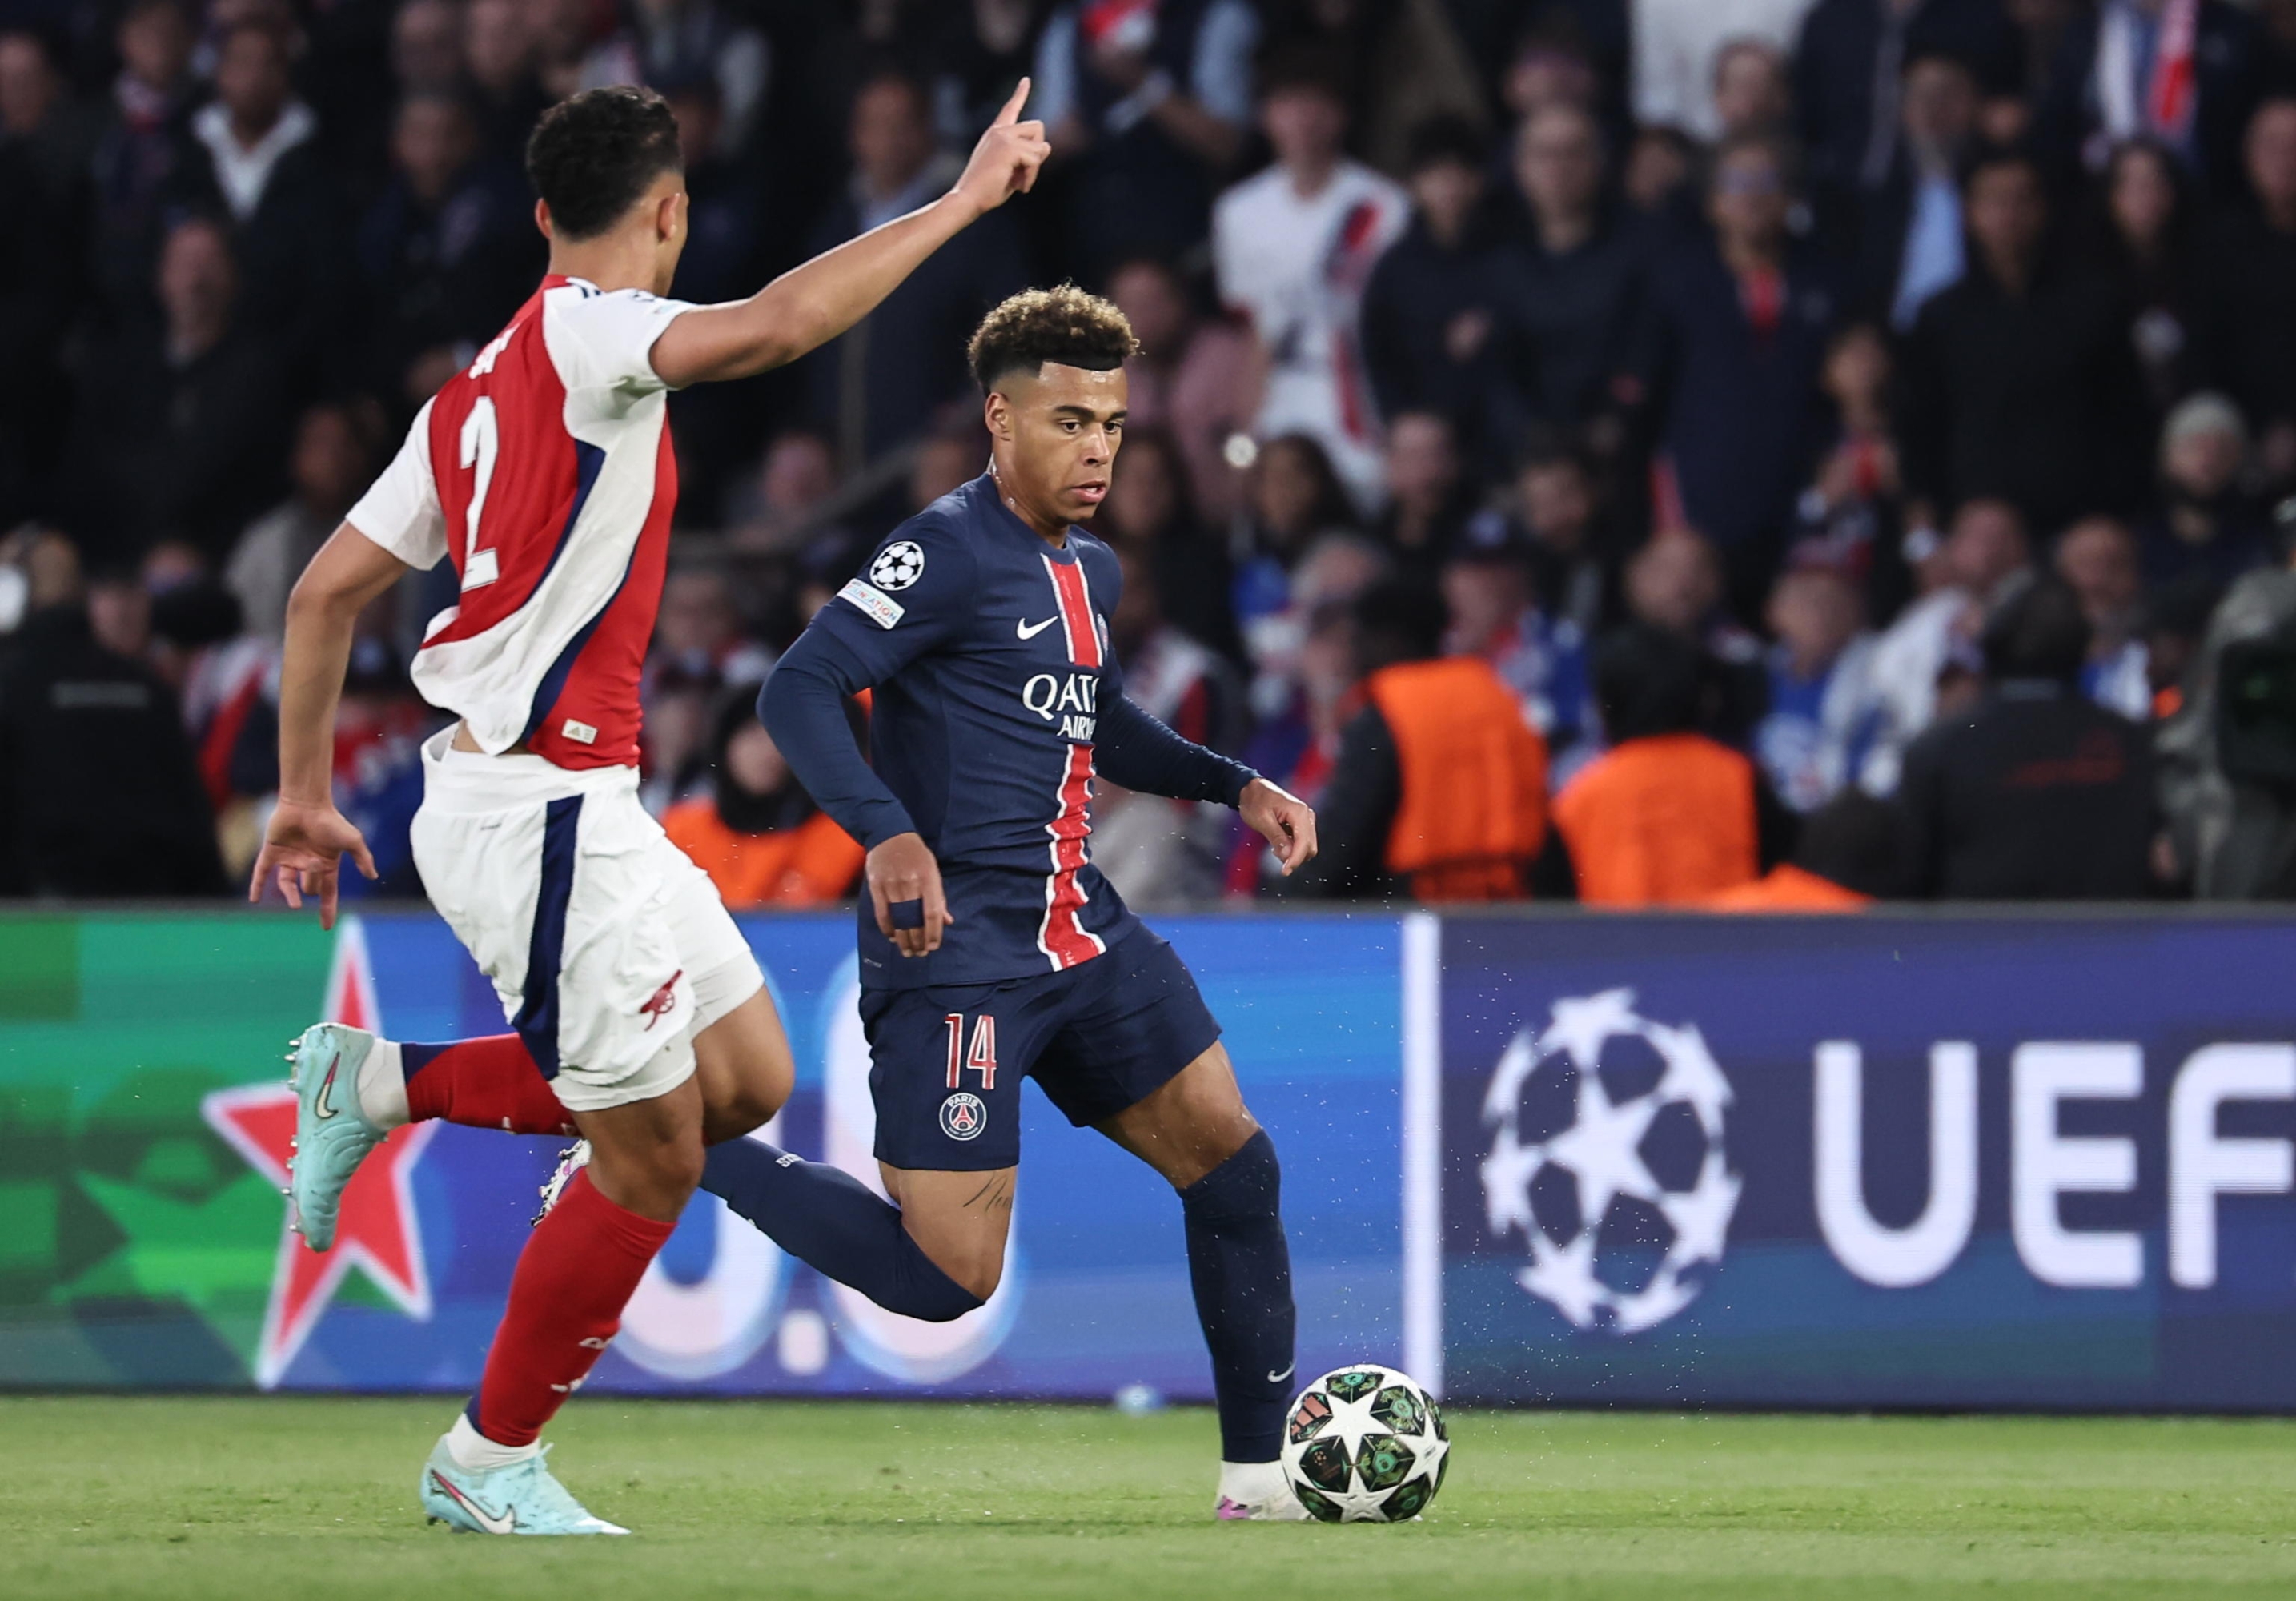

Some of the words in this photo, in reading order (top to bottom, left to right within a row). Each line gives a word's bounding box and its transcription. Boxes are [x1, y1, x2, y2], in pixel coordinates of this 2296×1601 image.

[460, 396, 500, 593] 2
[944, 1013, 998, 1089] 14
[947, 1095, 978, 1107] PARIS
